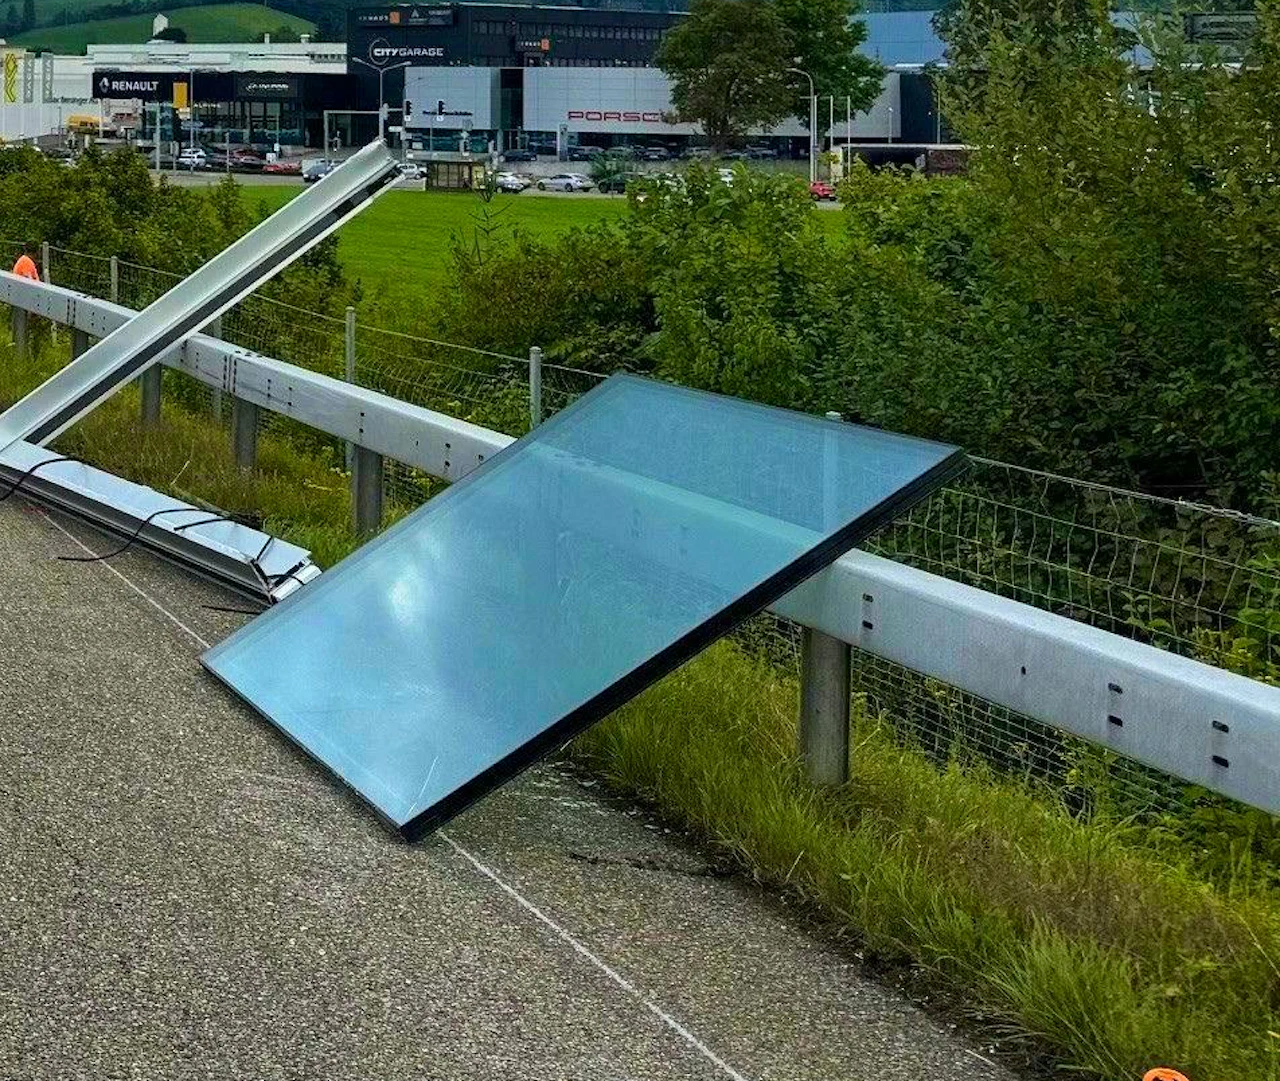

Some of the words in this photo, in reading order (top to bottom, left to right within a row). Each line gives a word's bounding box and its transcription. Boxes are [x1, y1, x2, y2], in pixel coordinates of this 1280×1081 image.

[373, 47, 444, 57] CITYGARAGE
[112, 81, 159, 91] RENAULT
[567, 111, 662, 123] PORSC
